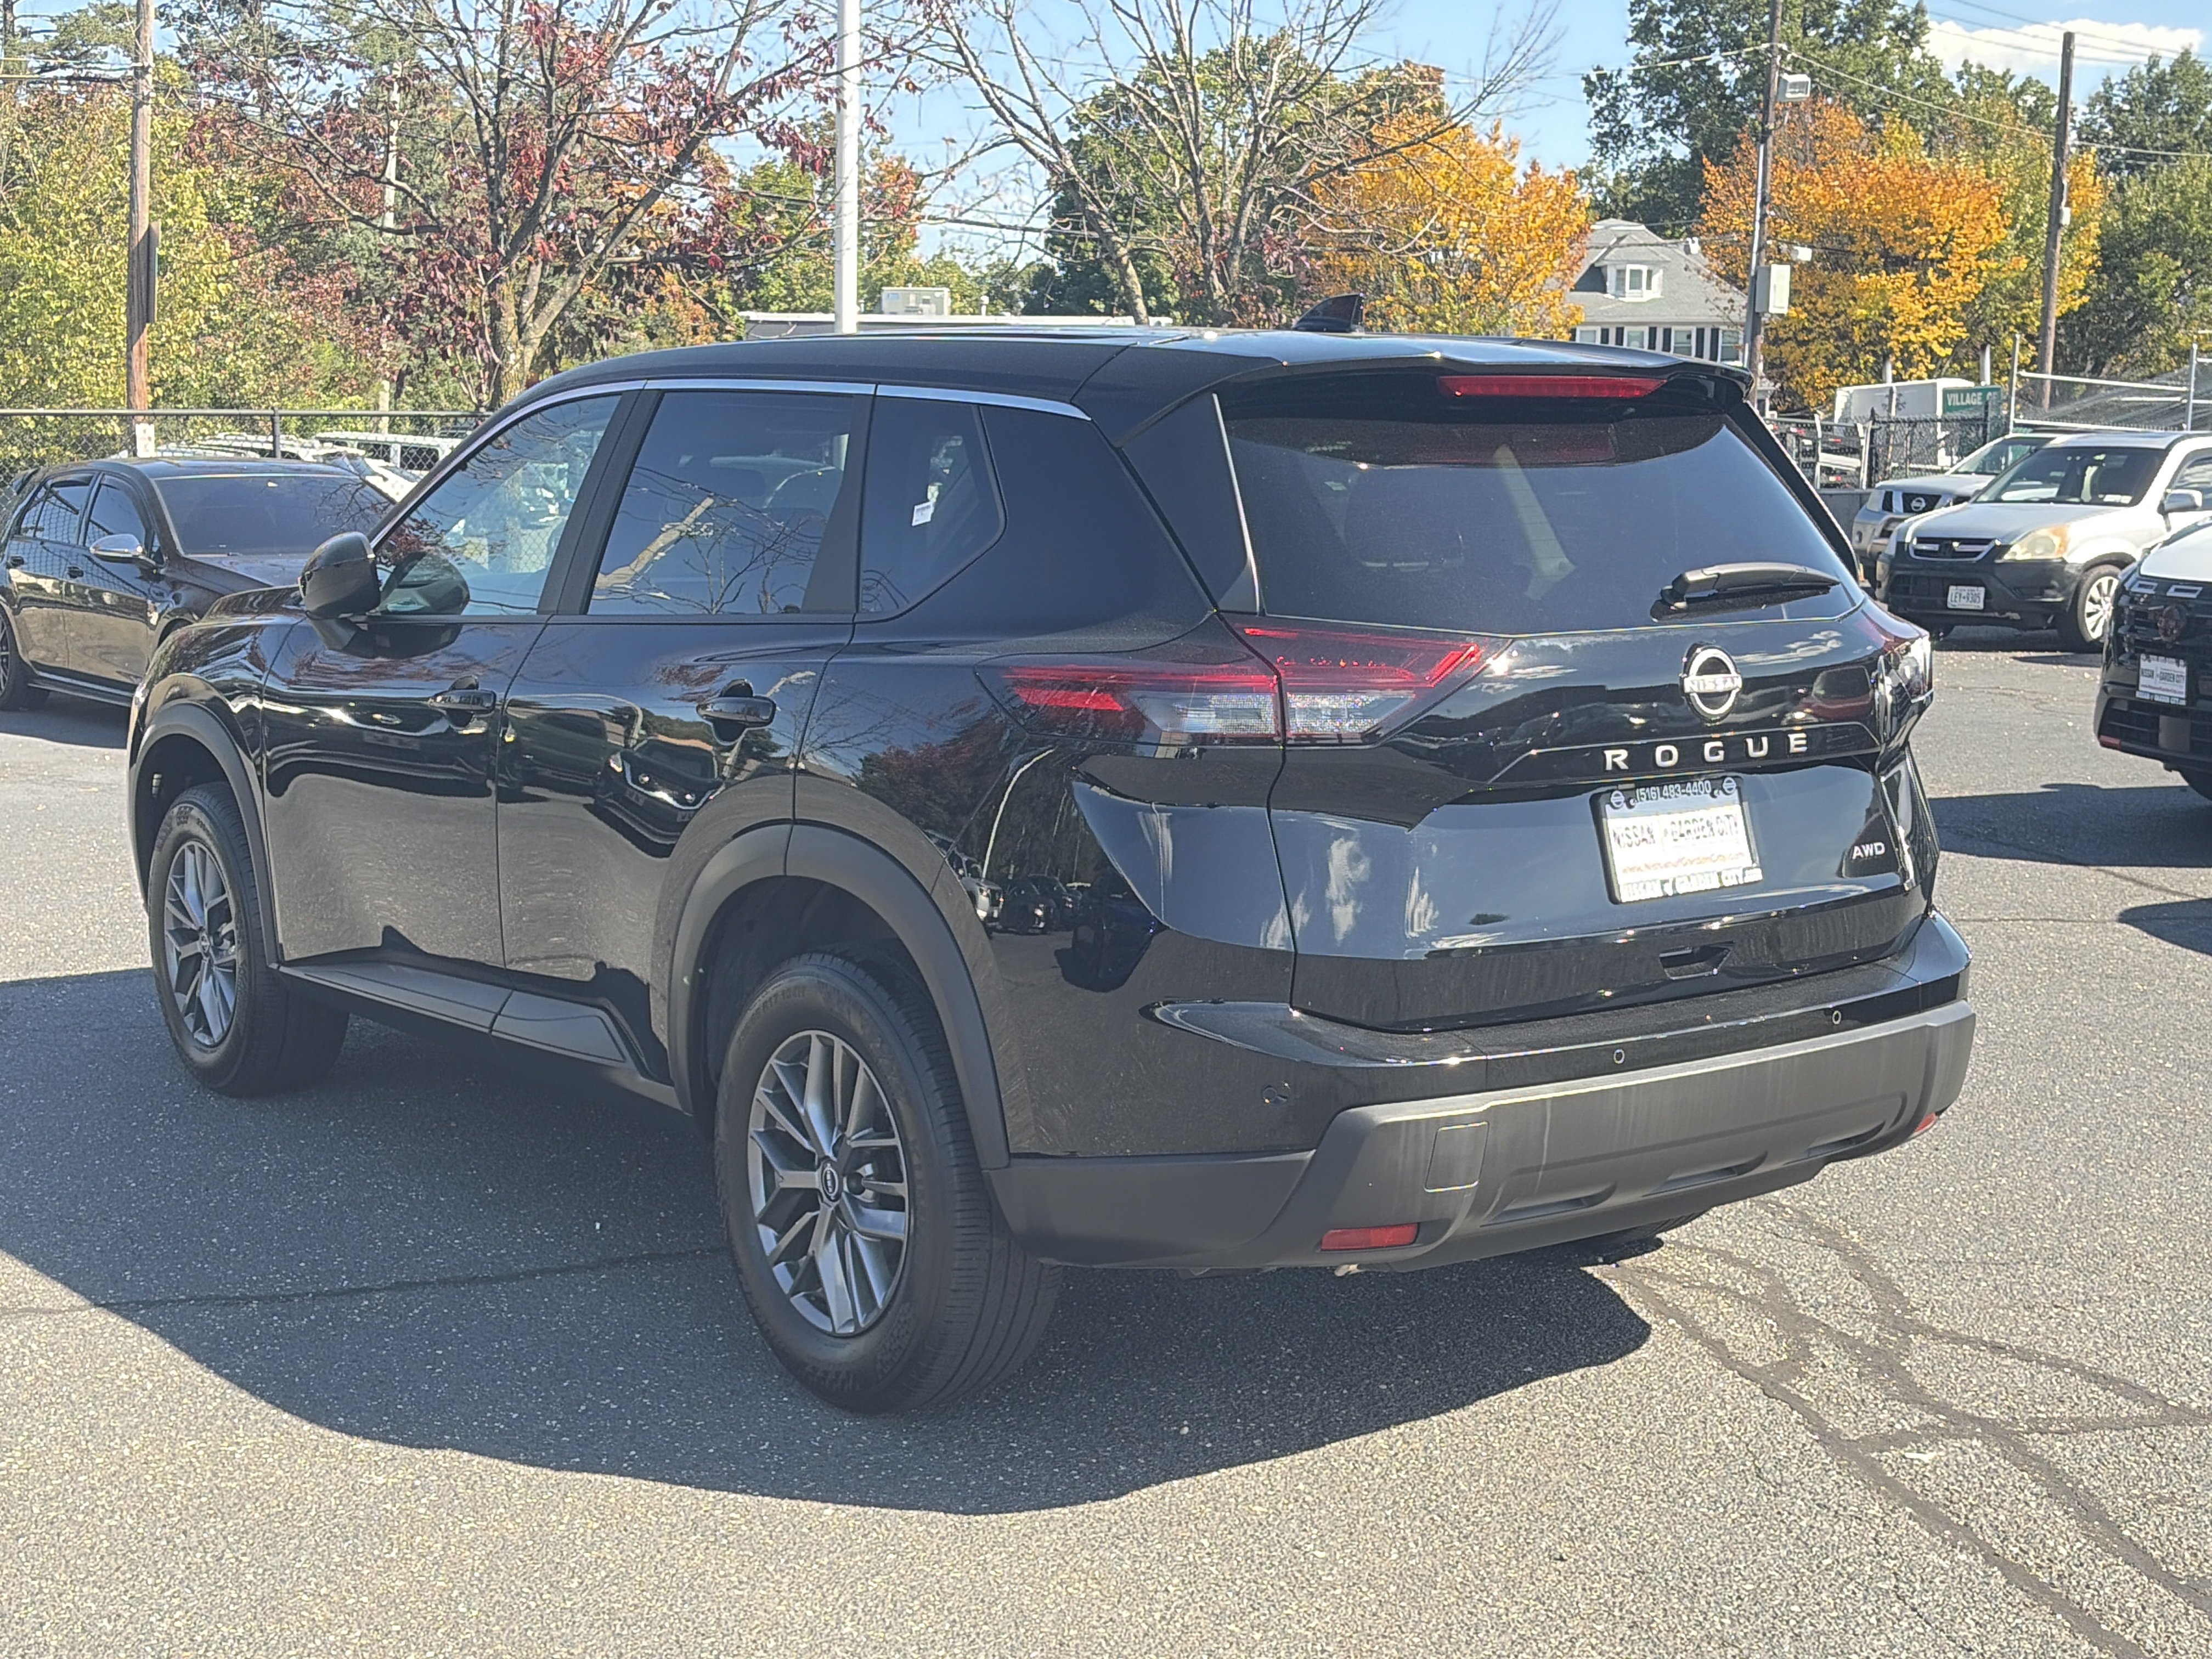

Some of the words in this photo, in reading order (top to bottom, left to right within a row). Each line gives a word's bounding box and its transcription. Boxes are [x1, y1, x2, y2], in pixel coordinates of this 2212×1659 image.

[1946, 392, 1983, 406] VILLAGE
[1685, 677, 1739, 692] NISSAN
[1604, 733, 1808, 771] ROGUE
[1635, 787, 1660, 801] (516)
[1662, 780, 1712, 798] 483-4400
[1613, 822, 1656, 849] NISSAN
[1669, 816, 1716, 842] GARDEN
[1716, 813, 1739, 837] CITY
[1852, 842, 1886, 860] AWD
